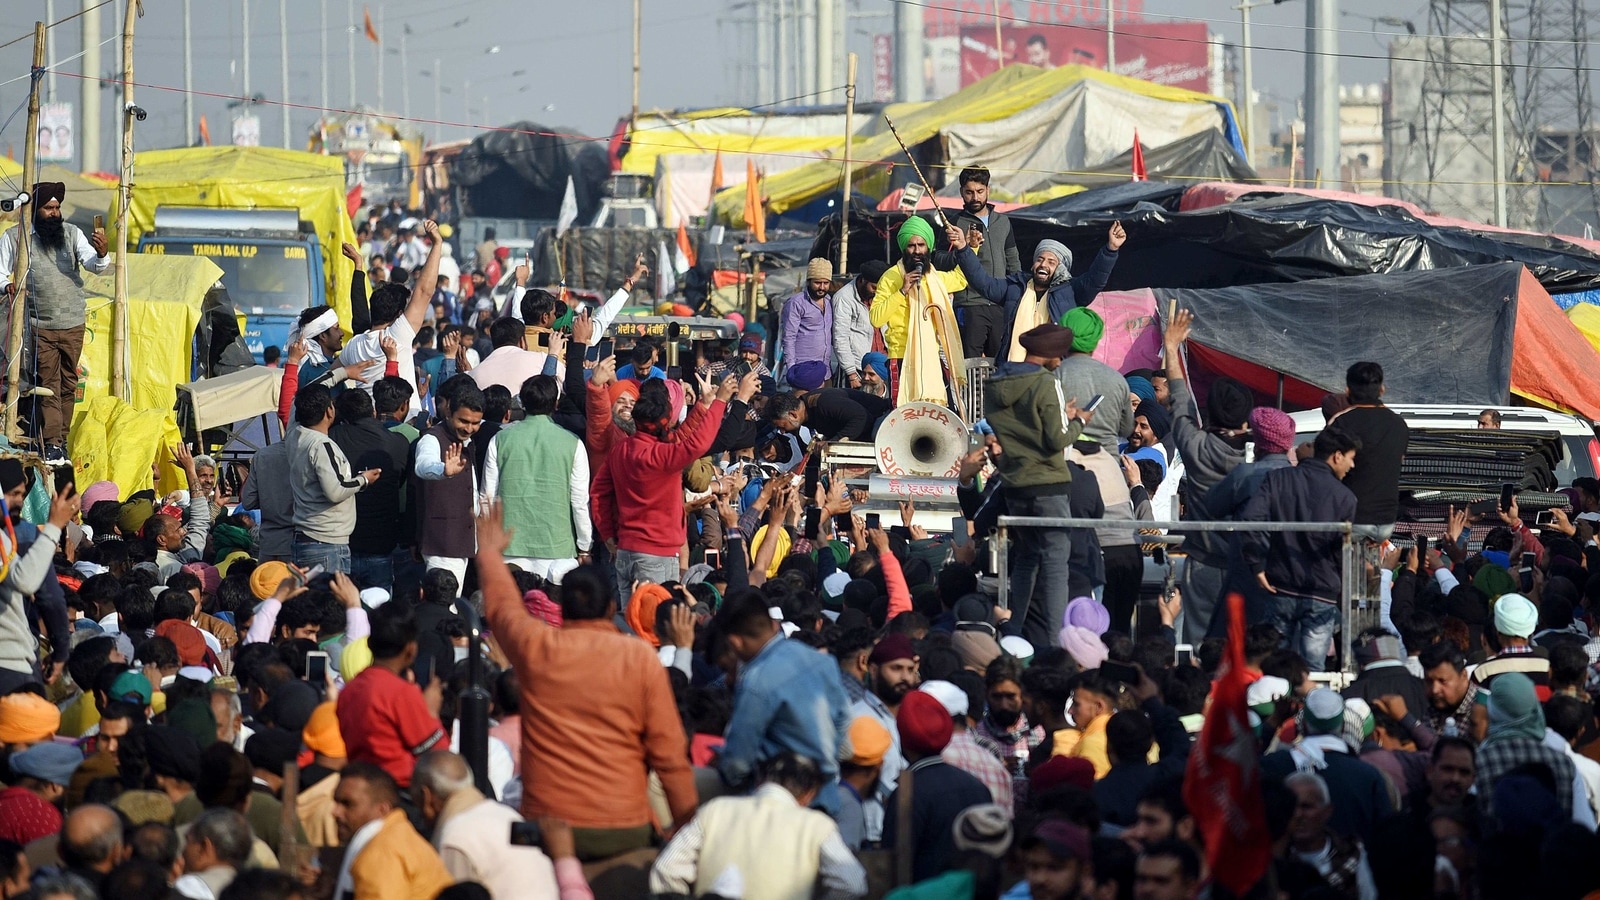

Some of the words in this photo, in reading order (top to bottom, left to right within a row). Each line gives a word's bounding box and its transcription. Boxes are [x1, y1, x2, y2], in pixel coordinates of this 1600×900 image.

[145, 244, 165, 254] KAR
[192, 244, 222, 256] TARNA
[223, 245, 240, 257] DAL
